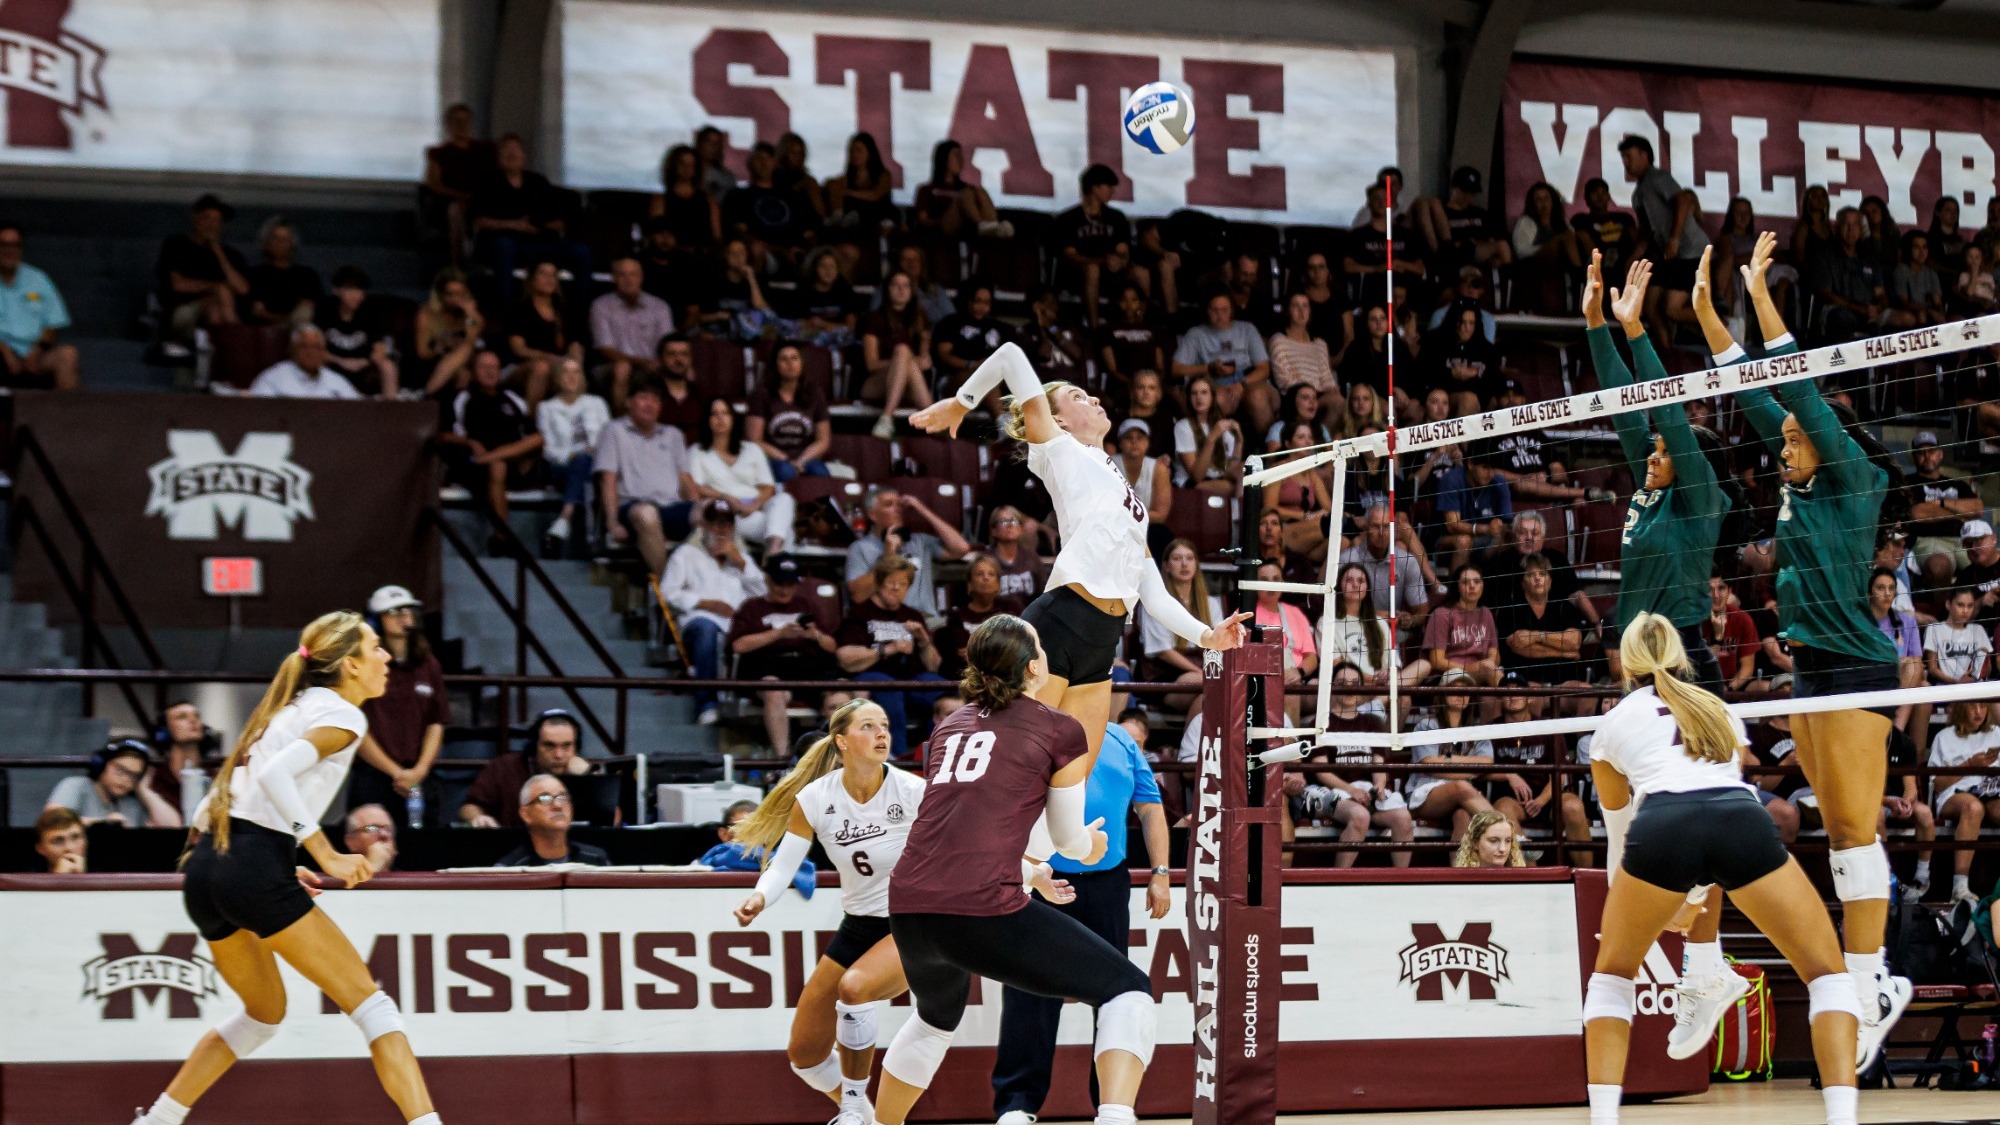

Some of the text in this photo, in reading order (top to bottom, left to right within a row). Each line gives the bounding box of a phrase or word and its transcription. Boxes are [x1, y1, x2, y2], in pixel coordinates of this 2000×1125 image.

[692, 28, 1287, 211] STATE
[1133, 105, 1169, 129] molten
[1520, 101, 1996, 229] VOLLEYB
[1865, 337, 1897, 360] HAIL
[1739, 361, 1768, 384] HAIL
[1621, 384, 1649, 406] HAIL
[1511, 406, 1537, 426] HAIL
[1409, 425, 1434, 445] HAIL
[177, 465, 283, 500] STATE
[932, 731, 997, 785] 18
[834, 820, 881, 842] State
[852, 851, 874, 876] 6
[1419, 947, 1489, 971] STATE
[107, 961, 193, 986] STATE
[1243, 934, 1260, 1058] sports imports
[1196, 945, 1219, 1102] HAIL
